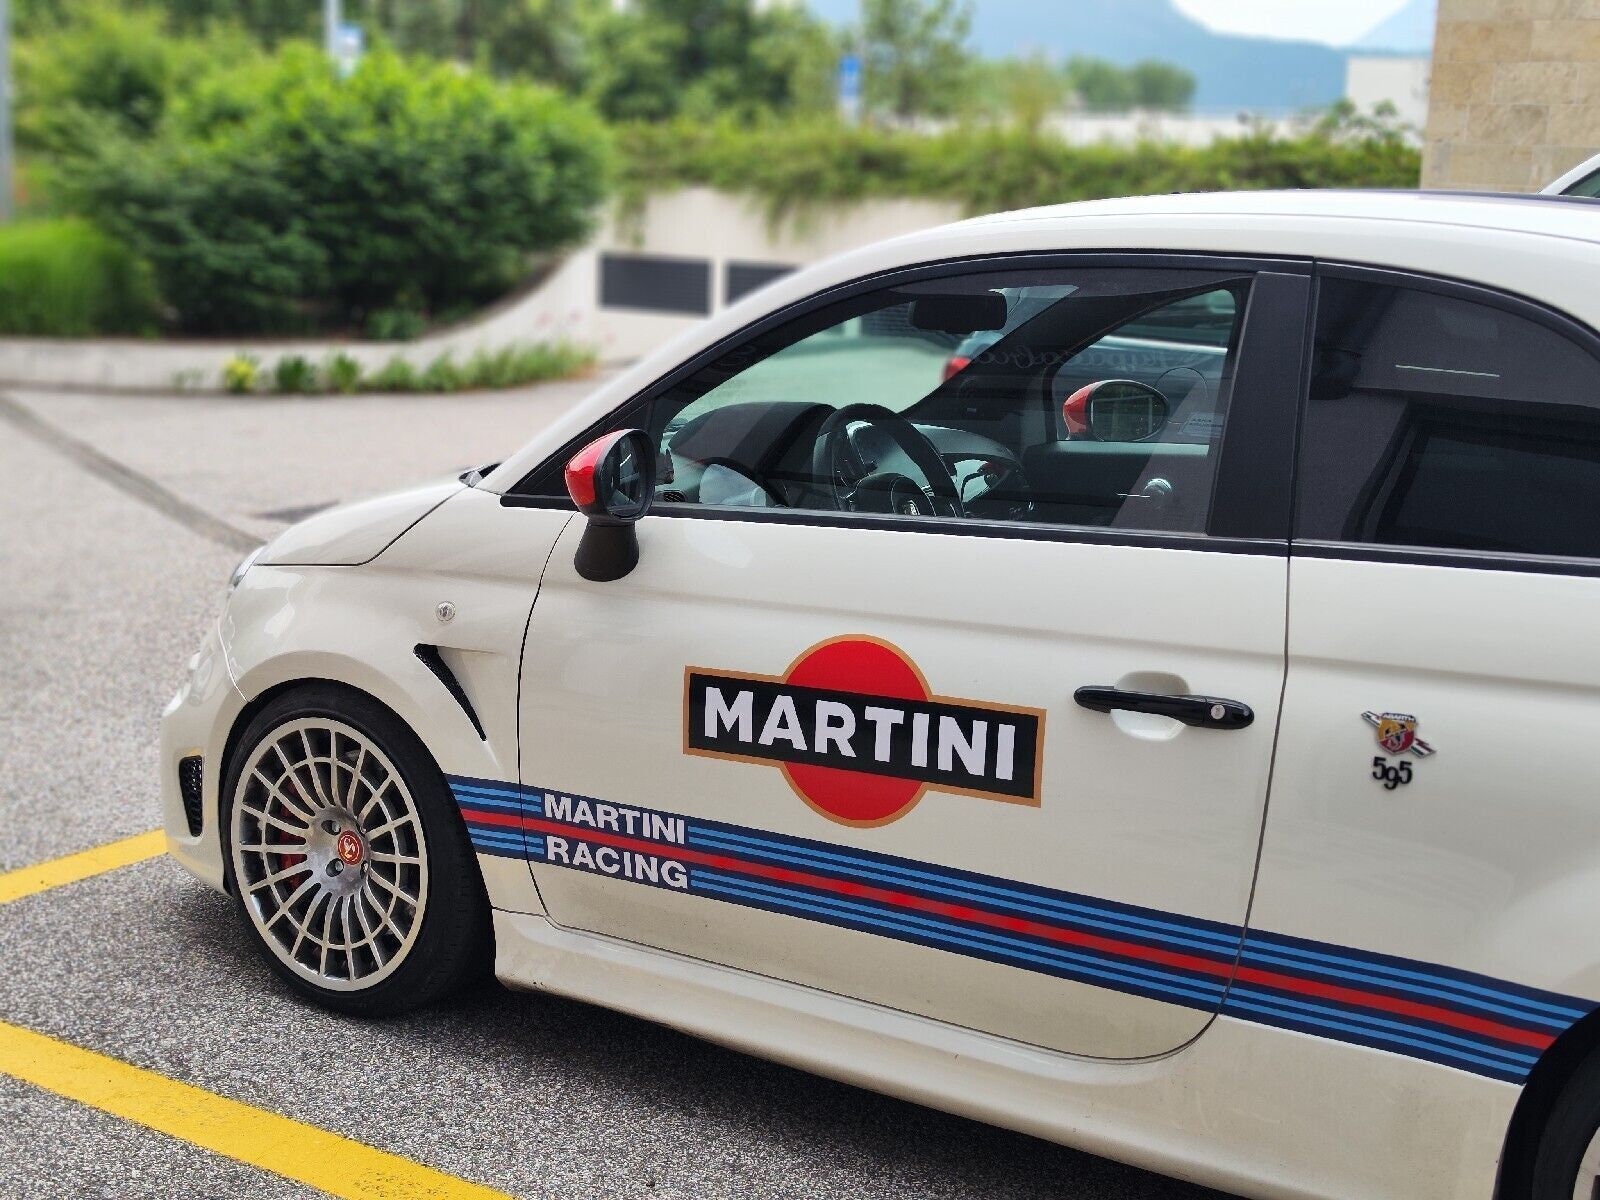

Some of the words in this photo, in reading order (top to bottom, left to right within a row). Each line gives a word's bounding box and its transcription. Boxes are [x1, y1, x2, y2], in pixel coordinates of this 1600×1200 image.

[704, 686, 1016, 780] MARTINI
[1372, 756, 1413, 790] 595
[544, 792, 685, 845] MARTINI
[546, 835, 689, 889] RACING
